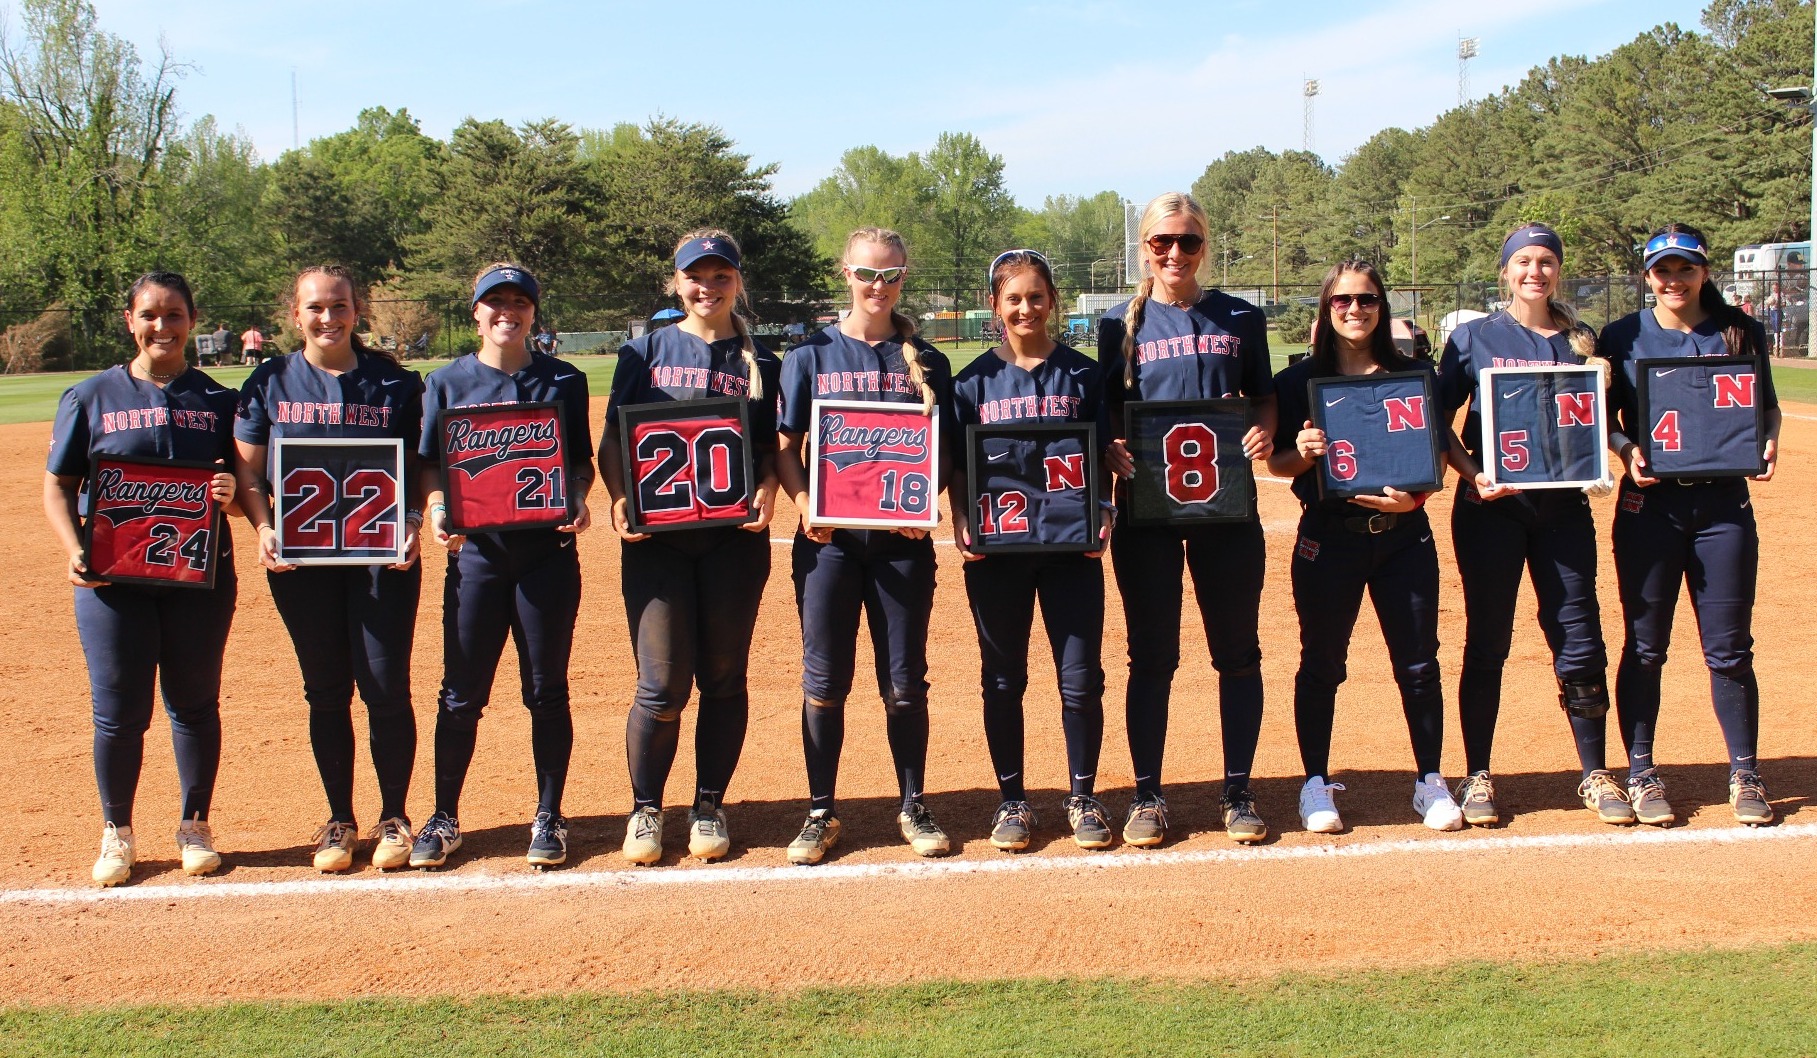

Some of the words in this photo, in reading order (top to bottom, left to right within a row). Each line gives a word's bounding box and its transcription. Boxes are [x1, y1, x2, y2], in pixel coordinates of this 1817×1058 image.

[1556, 392, 1595, 427] N
[1713, 374, 1756, 408] N
[819, 414, 928, 458] Rangers
[1383, 396, 1426, 432] N
[1651, 410, 1681, 452] 4
[447, 418, 556, 459] Rangers
[1327, 439, 1359, 482] 6
[1500, 430, 1529, 472] 5
[637, 427, 749, 513] 20
[1044, 453, 1086, 492] N
[1163, 422, 1220, 505] 8
[96, 468, 208, 513] Rangers
[282, 467, 397, 551] 22
[516, 466, 566, 510] 21
[879, 470, 930, 515] 18
[978, 490, 1029, 535] 12
[145, 523, 210, 571] 24
